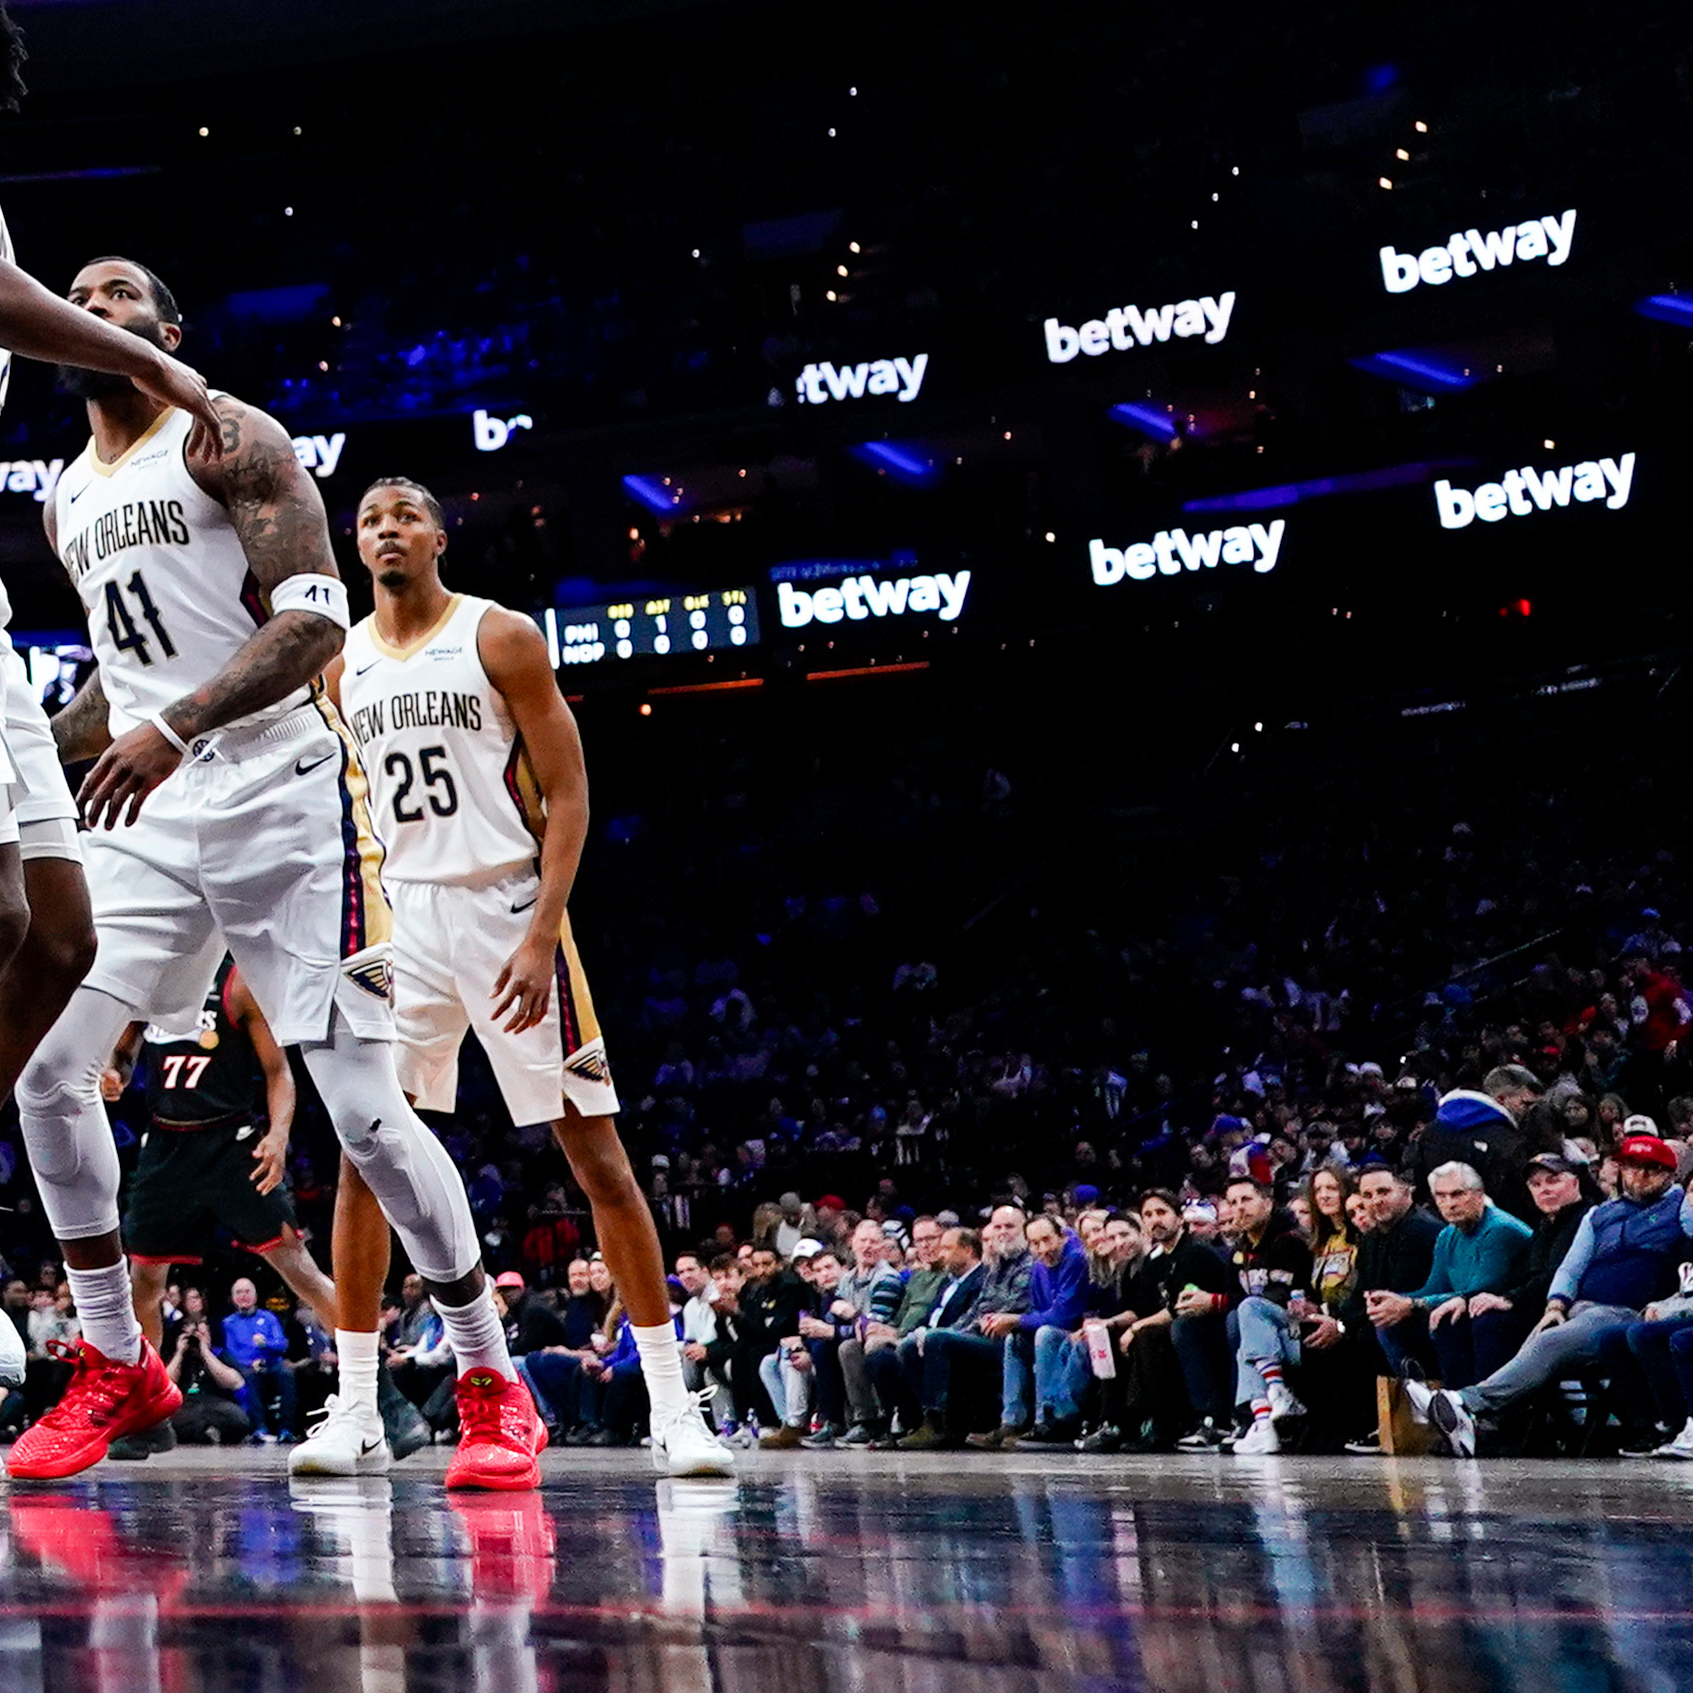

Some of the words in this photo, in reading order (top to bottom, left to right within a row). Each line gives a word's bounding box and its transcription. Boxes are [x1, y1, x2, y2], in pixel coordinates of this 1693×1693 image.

[1379, 208, 1578, 294] betway
[1044, 291, 1236, 364] betway
[796, 353, 929, 404] tway
[1435, 452, 1636, 529] betway
[95, 499, 190, 560] ORLEANS
[1089, 519, 1286, 585] betway
[104, 569, 180, 667] 41
[304, 584, 331, 606] 41
[777, 570, 971, 627] betway
[391, 690, 482, 732] ORLEANS
[384, 745, 459, 823] 25
[162, 1054, 213, 1090] 77
